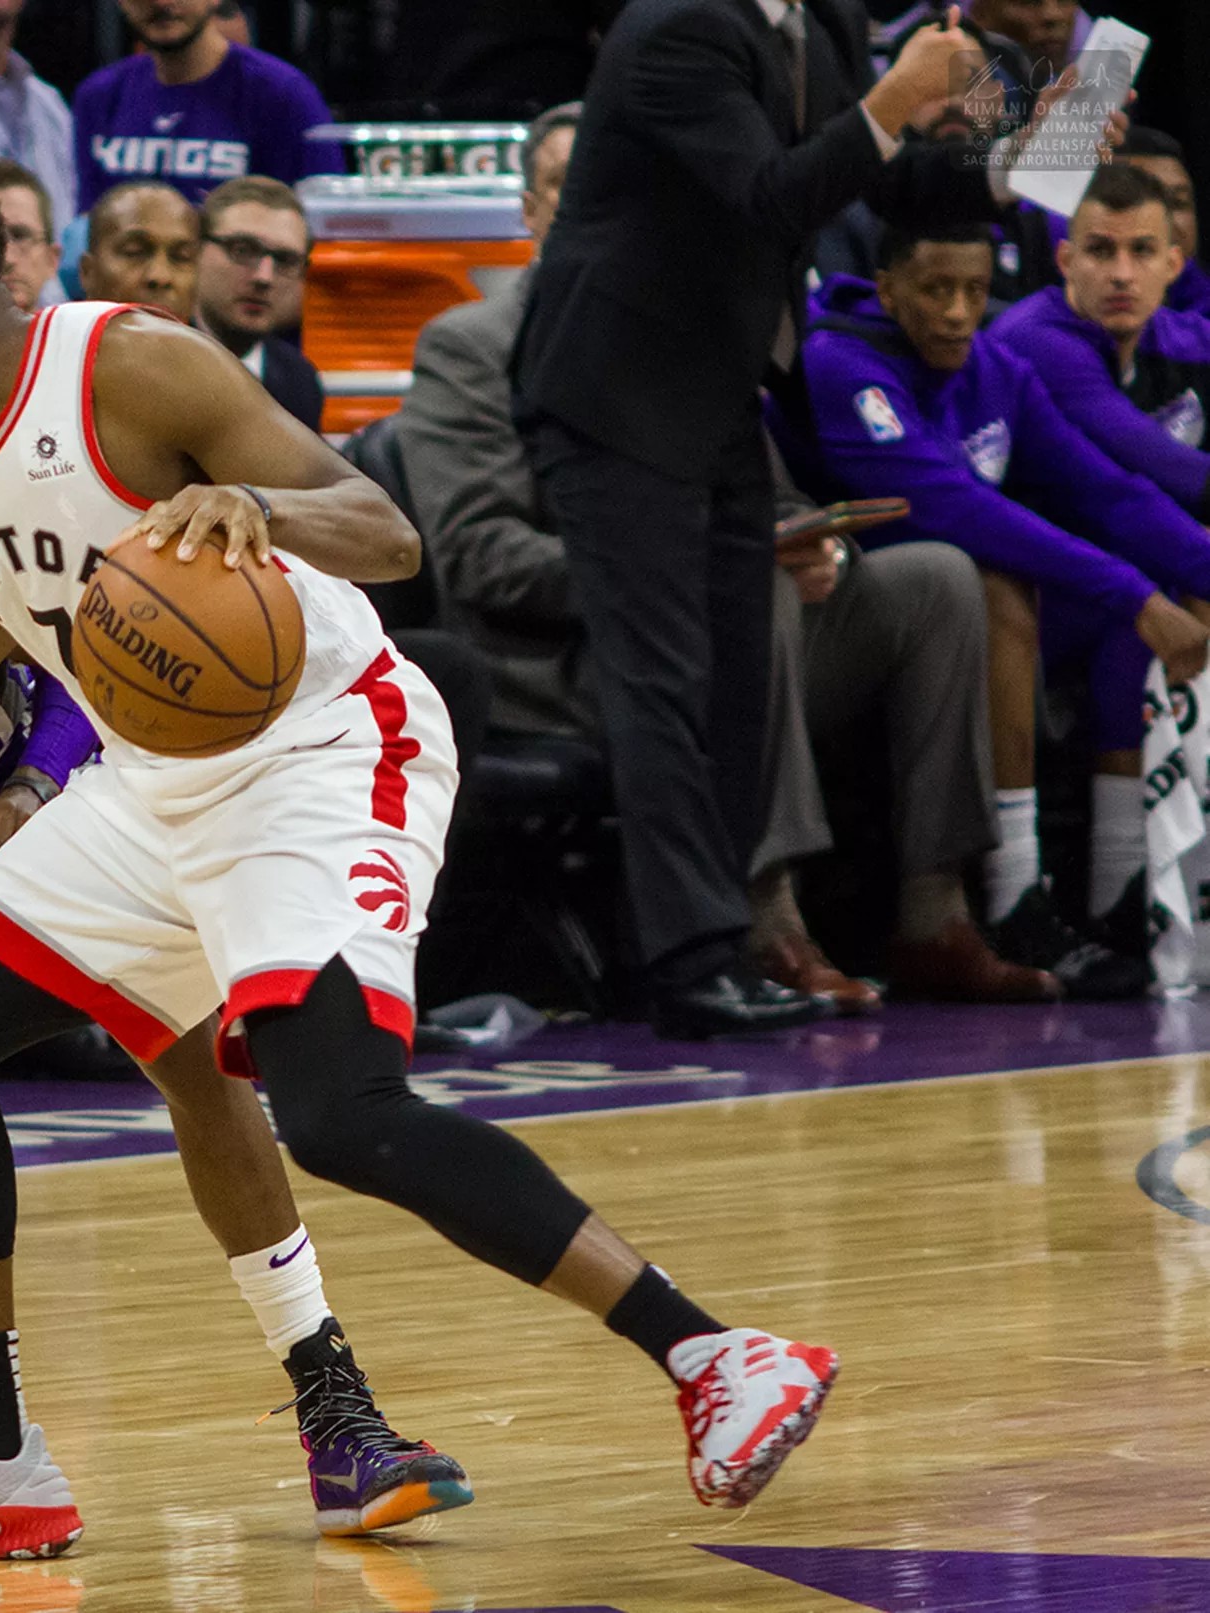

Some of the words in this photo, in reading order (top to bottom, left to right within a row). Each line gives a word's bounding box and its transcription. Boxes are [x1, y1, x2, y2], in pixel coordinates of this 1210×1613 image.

[92, 134, 249, 176] KINGS
[28, 468, 51, 481] Sun
[53, 461, 75, 476] Life
[81, 582, 203, 698] SPALDING
